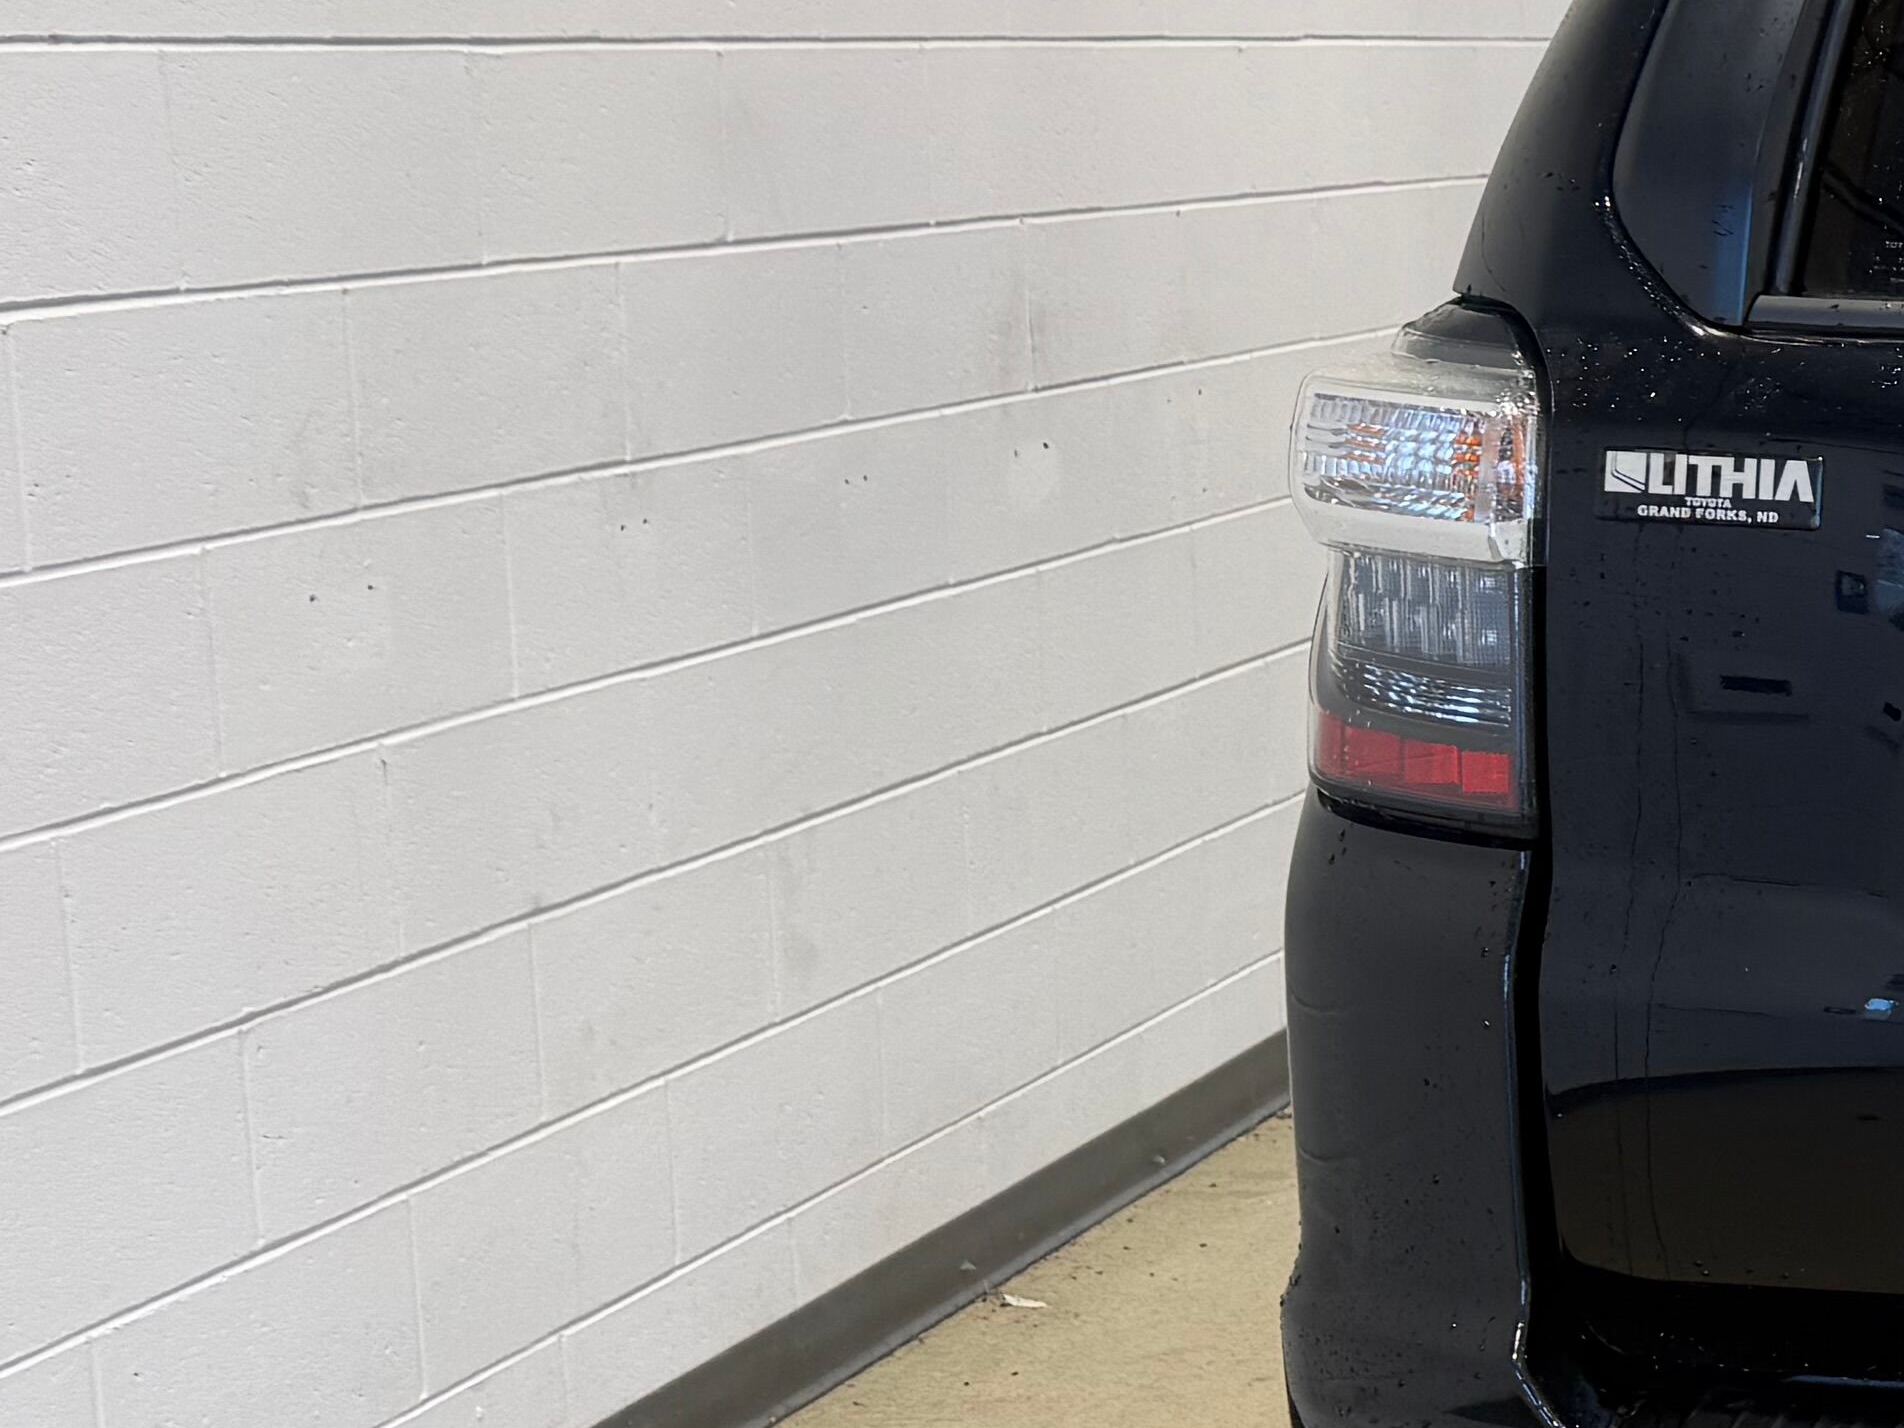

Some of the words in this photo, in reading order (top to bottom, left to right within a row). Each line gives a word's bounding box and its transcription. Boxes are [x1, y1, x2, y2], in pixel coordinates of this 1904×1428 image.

[1647, 452, 1815, 503] LITHIA
[1684, 496, 1732, 508] TOYOTA
[1636, 504, 1692, 519] GRAND
[1694, 507, 1753, 523] FORKS,
[1756, 510, 1780, 523] ND
